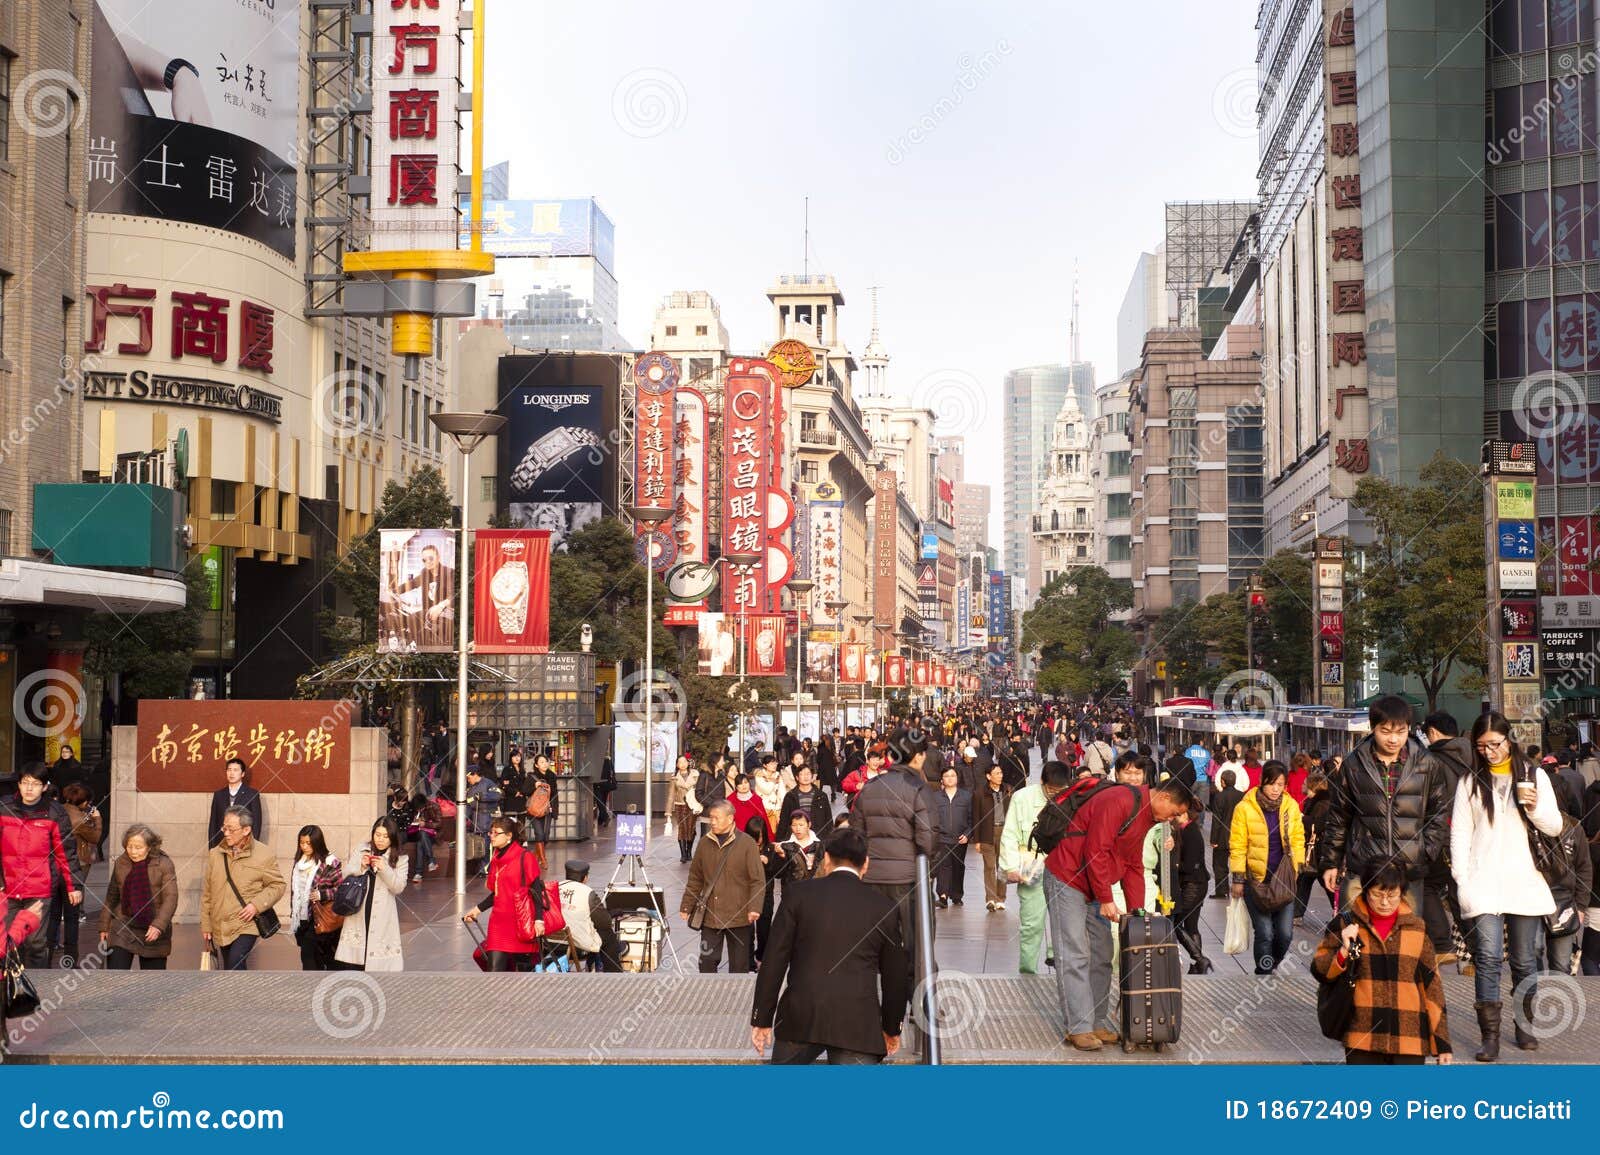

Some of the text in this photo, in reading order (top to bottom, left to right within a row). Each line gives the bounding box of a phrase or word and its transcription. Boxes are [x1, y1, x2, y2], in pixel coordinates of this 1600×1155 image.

[387, 0, 440, 206] 方商厦
[129, 370, 236, 406] SHOPPING
[523, 394, 590, 405] LONGINES
[643, 401, 668, 509] 亨達利鐘
[1502, 569, 1533, 577] GANESH
[1543, 652, 1584, 661] 巴克咖啡
[151, 723, 335, 769] 南京路步行街
